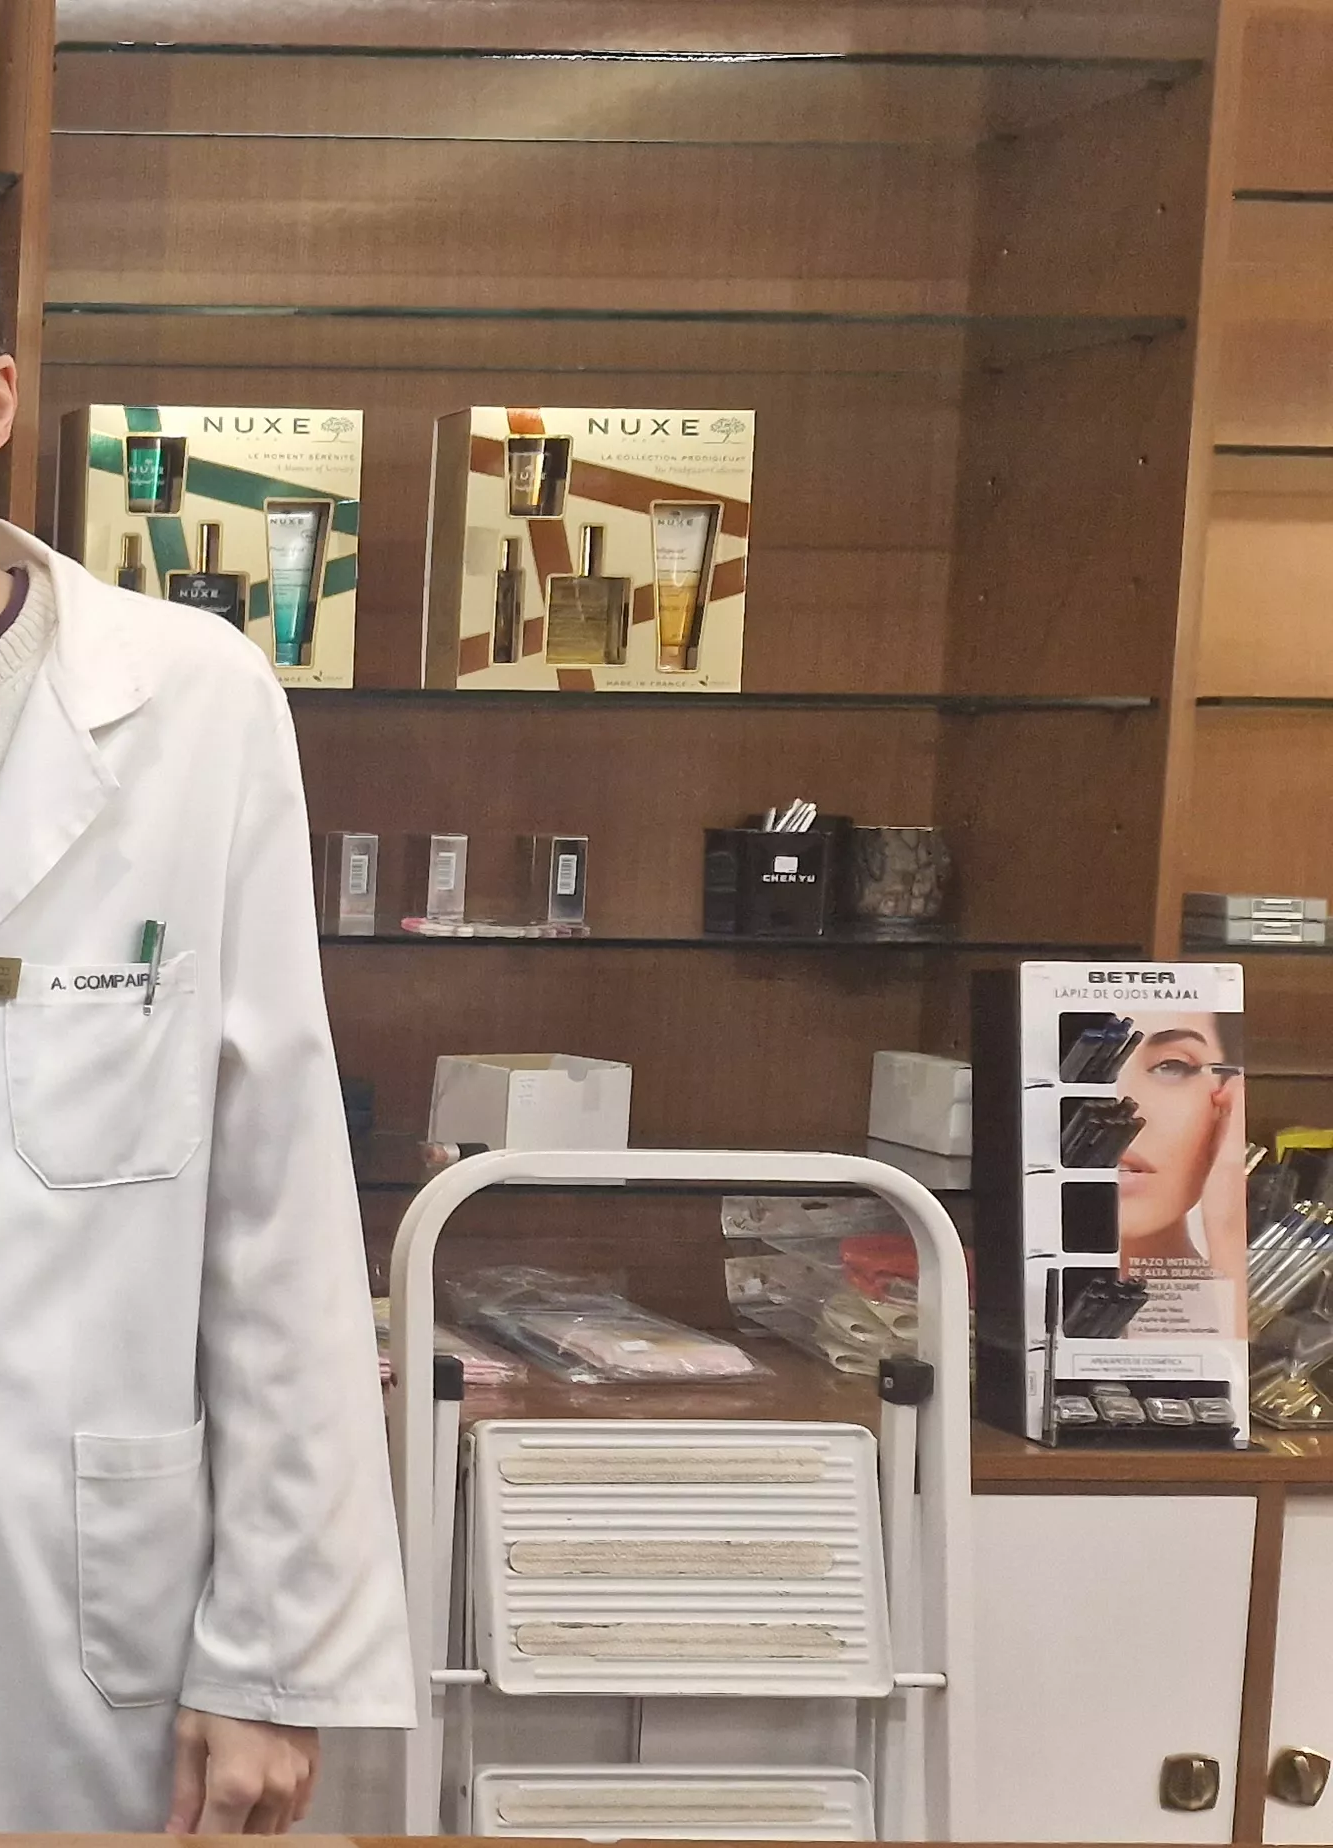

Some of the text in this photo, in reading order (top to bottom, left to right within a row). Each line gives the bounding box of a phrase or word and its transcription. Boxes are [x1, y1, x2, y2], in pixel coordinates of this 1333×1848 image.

[203, 416, 311, 434] NUXE
[588, 417, 700, 436] NUXE
[179, 589, 219, 598] NUXE
[762, 874, 816, 883] CHEN YU
[50, 976, 67, 990] A.
[1088, 971, 1176, 984] BETER
[1054, 984, 1200, 1000] LÁPIZ DE OJOS KAJAL
[1128, 1257, 1210, 1267] TRAZO INTENSO
[1128, 1267, 1142, 1277] DE
[1144, 1267, 1169, 1277] ALTA
